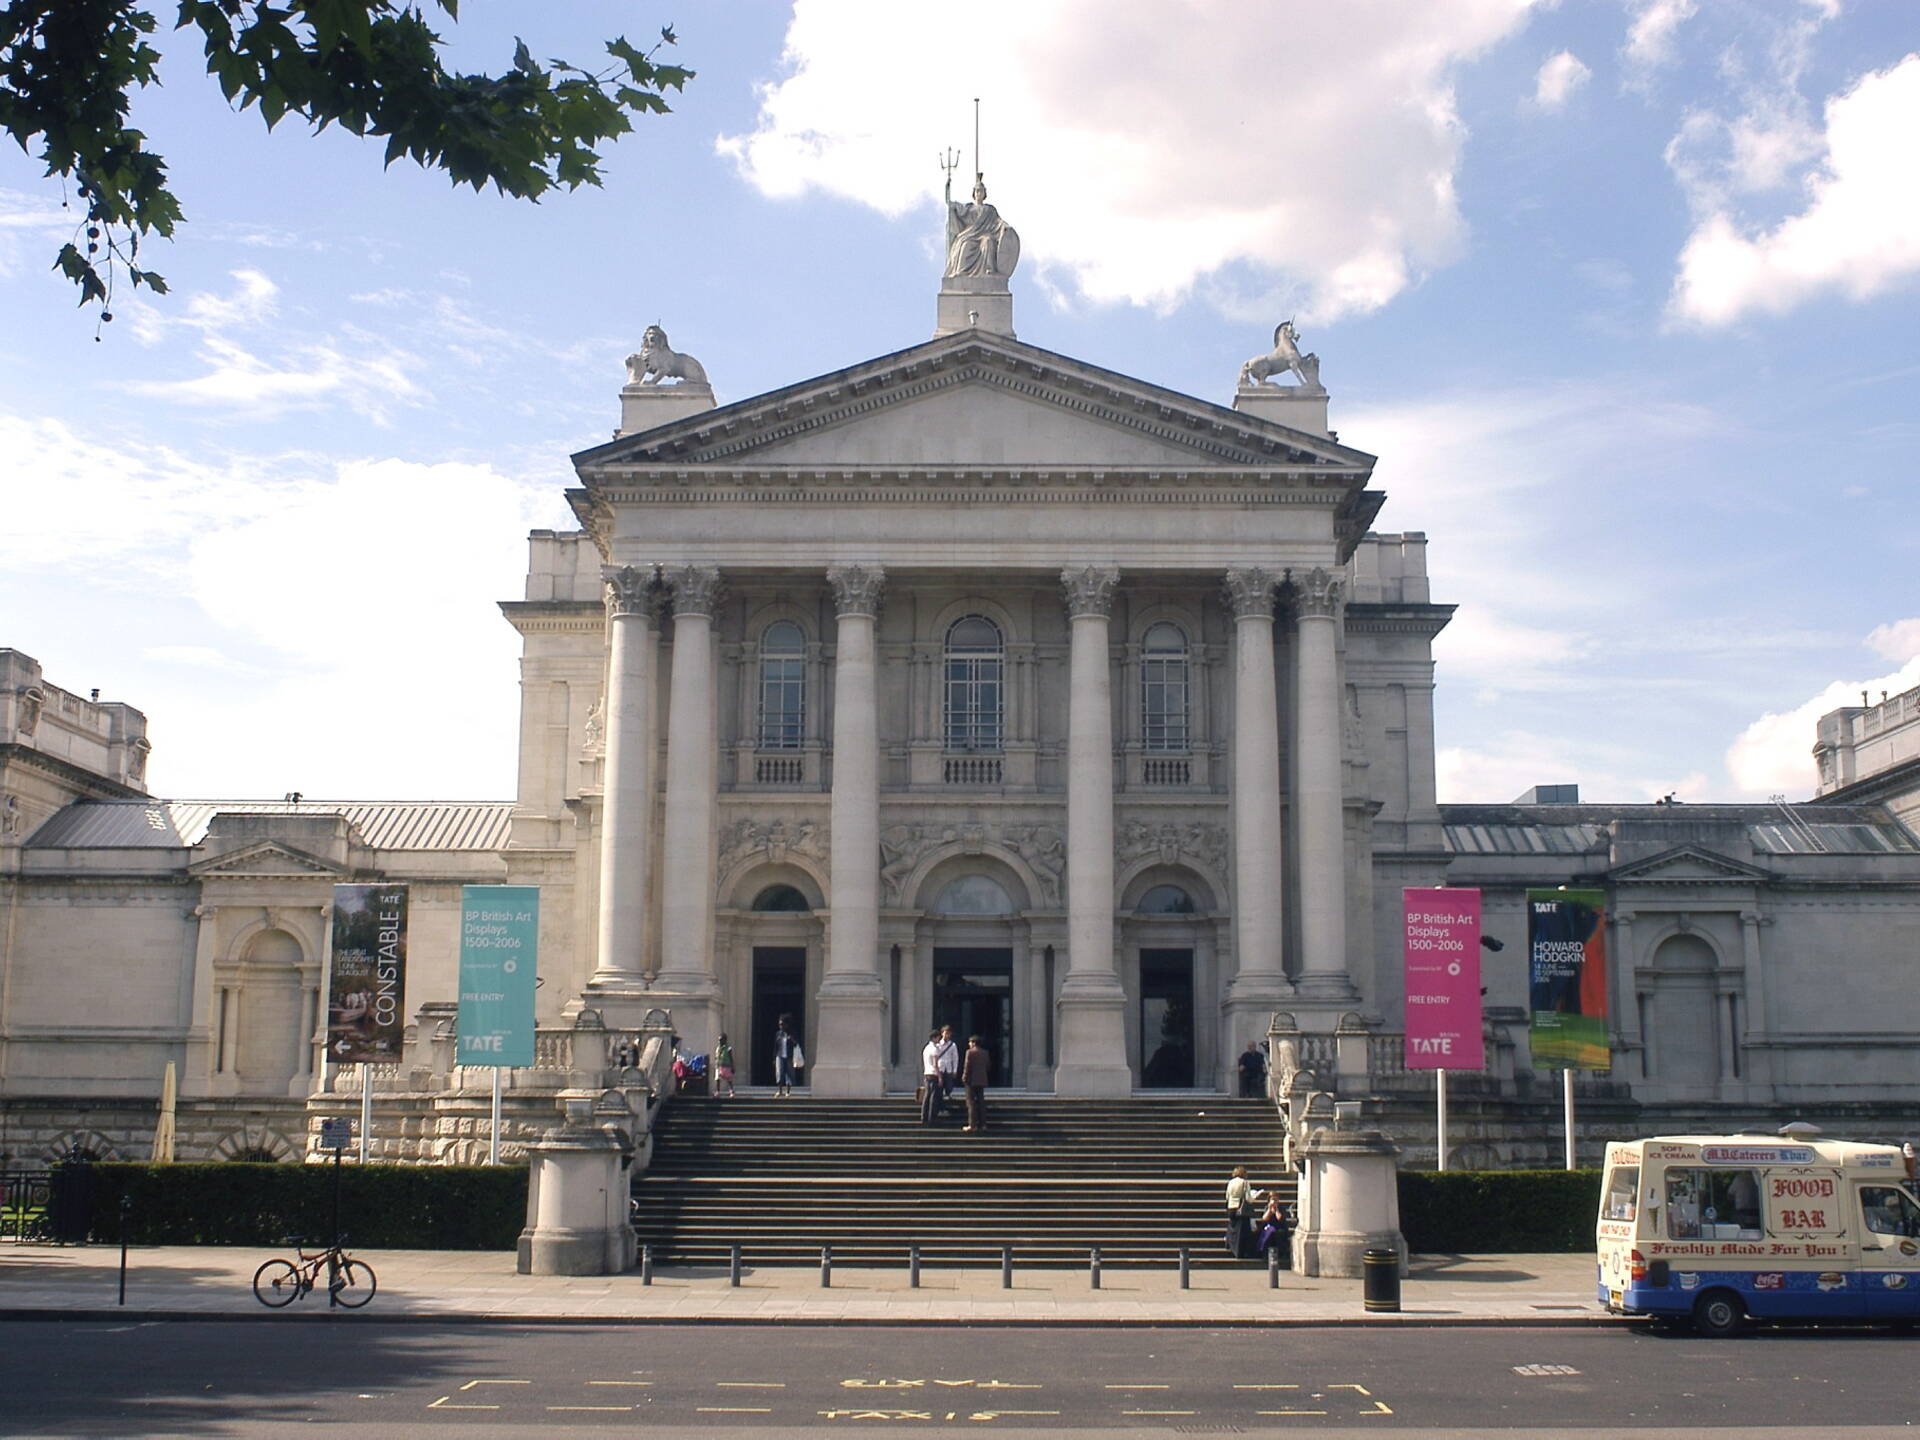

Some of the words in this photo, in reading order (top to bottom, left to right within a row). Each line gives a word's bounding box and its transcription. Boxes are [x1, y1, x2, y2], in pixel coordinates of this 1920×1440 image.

[380, 895, 400, 905] TATE
[1534, 902, 1557, 913] TATE
[465, 911, 479, 921] BP
[481, 911, 512, 922] British
[514, 912, 532, 922] Art
[1407, 913, 1422, 924] BP
[1424, 913, 1455, 925] British
[1457, 914, 1473, 925] Art
[465, 923, 508, 936] Displays
[1407, 926, 1450, 939] Displays
[1407, 939, 1464, 951] 1500–2006
[1534, 942, 1584, 952] HOWARD
[1534, 952, 1586, 962] HODGKIN
[375, 911, 399, 1026] CONSTABLE
[463, 992, 479, 1001] FREE
[480, 992, 504, 1001] ENTRY
[1408, 995, 1425, 1004] FREE
[1427, 995, 1450, 1005] ENTRY
[463, 1035, 503, 1052] TATE
[1411, 1038, 1452, 1055] TATE
[1772, 1179, 1833, 1197] FOOD
[1780, 1210, 1826, 1228] BAR
[1650, 1243, 1715, 1256] Freshly
[1720, 1243, 1765, 1255] Made
[1769, 1243, 1800, 1255] For
[1805, 1244, 1837, 1258] You
